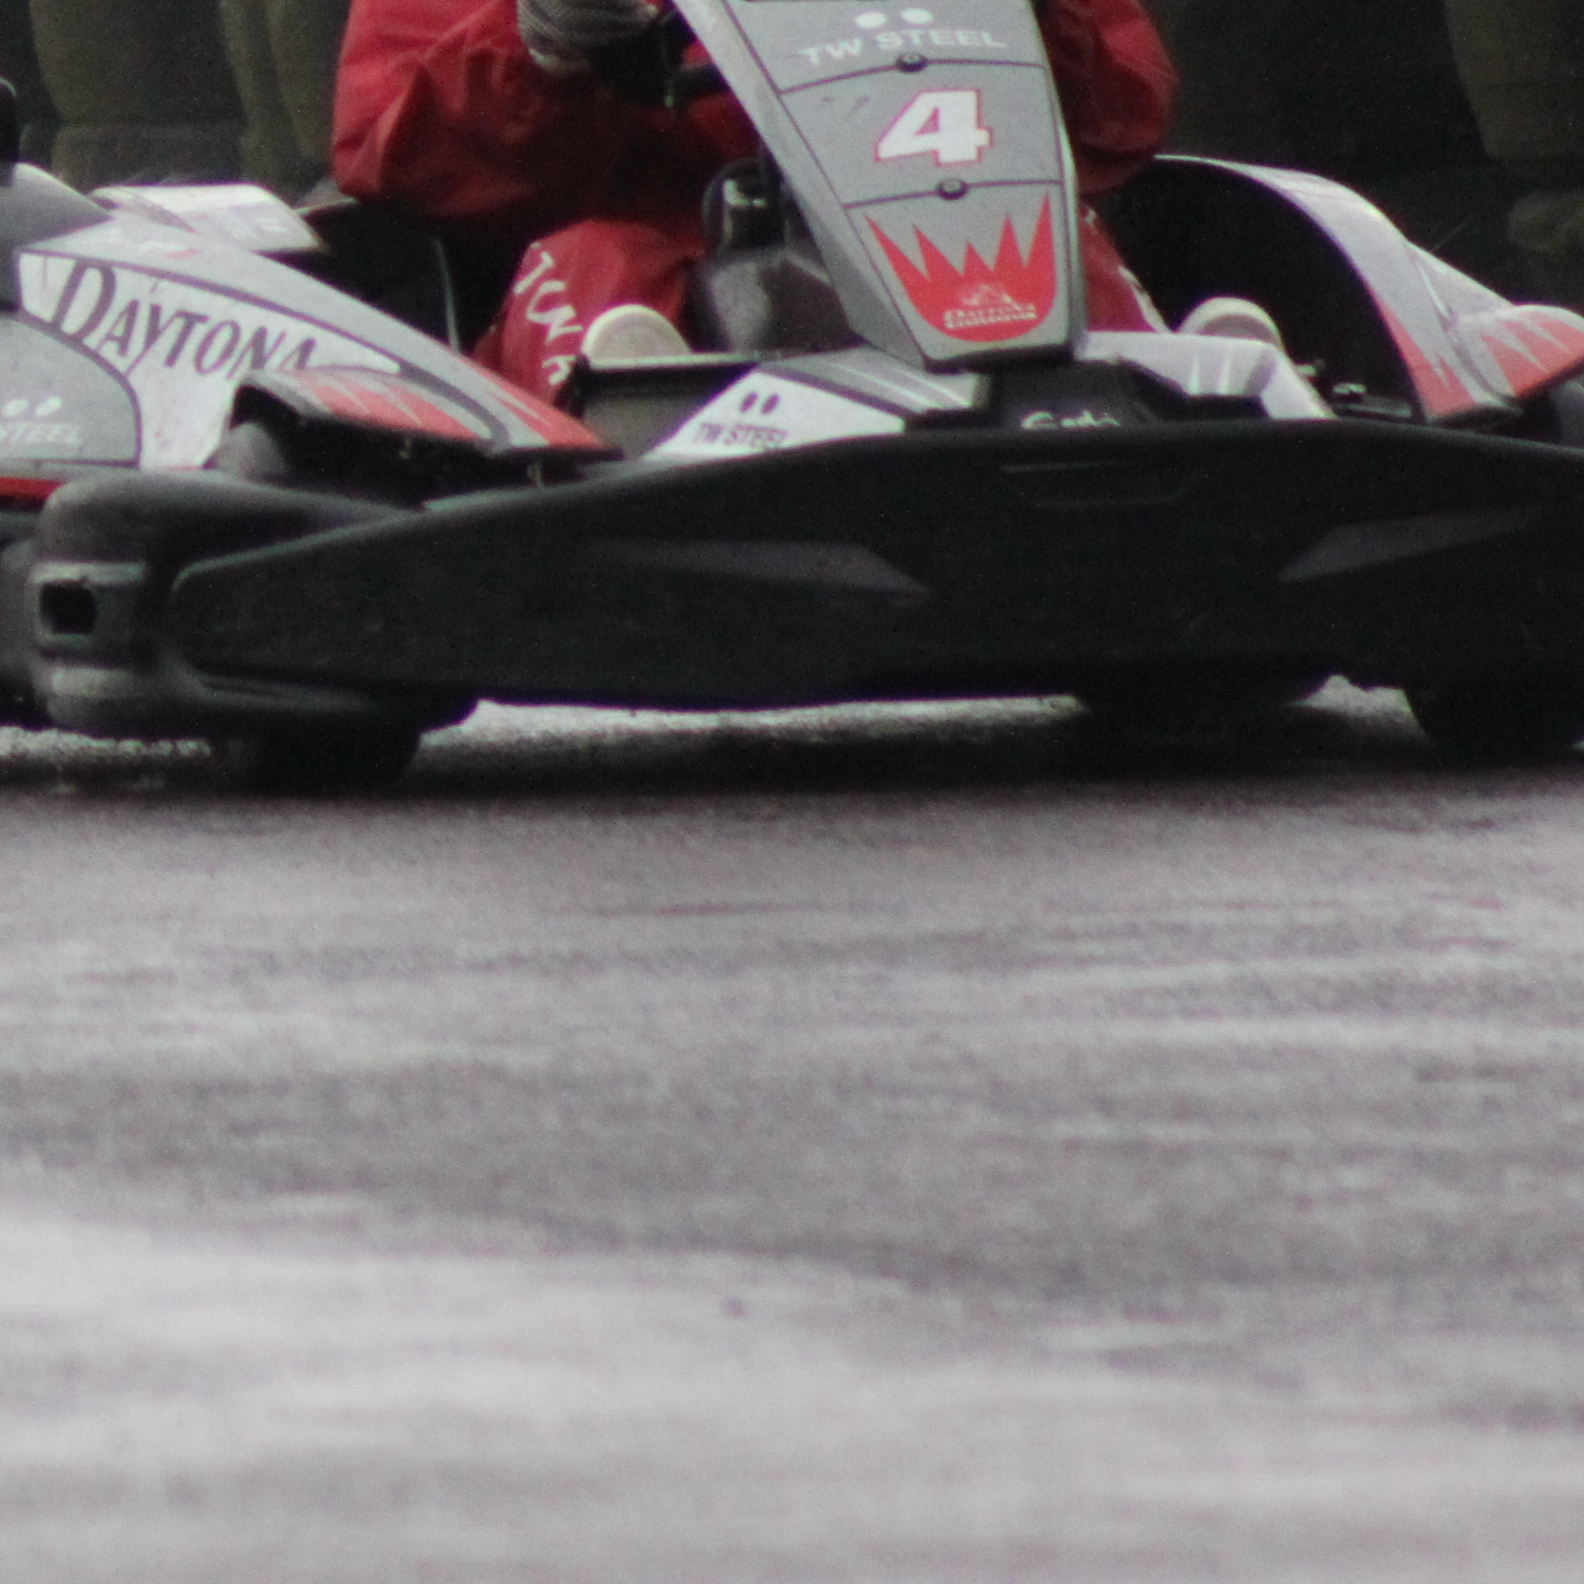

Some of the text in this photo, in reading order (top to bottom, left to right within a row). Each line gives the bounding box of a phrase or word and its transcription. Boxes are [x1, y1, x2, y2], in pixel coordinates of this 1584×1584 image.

[797, 28, 1007, 65] TW STEEL
[873, 87, 995, 167] 4
[51, 260, 317, 382] DAYTONA
